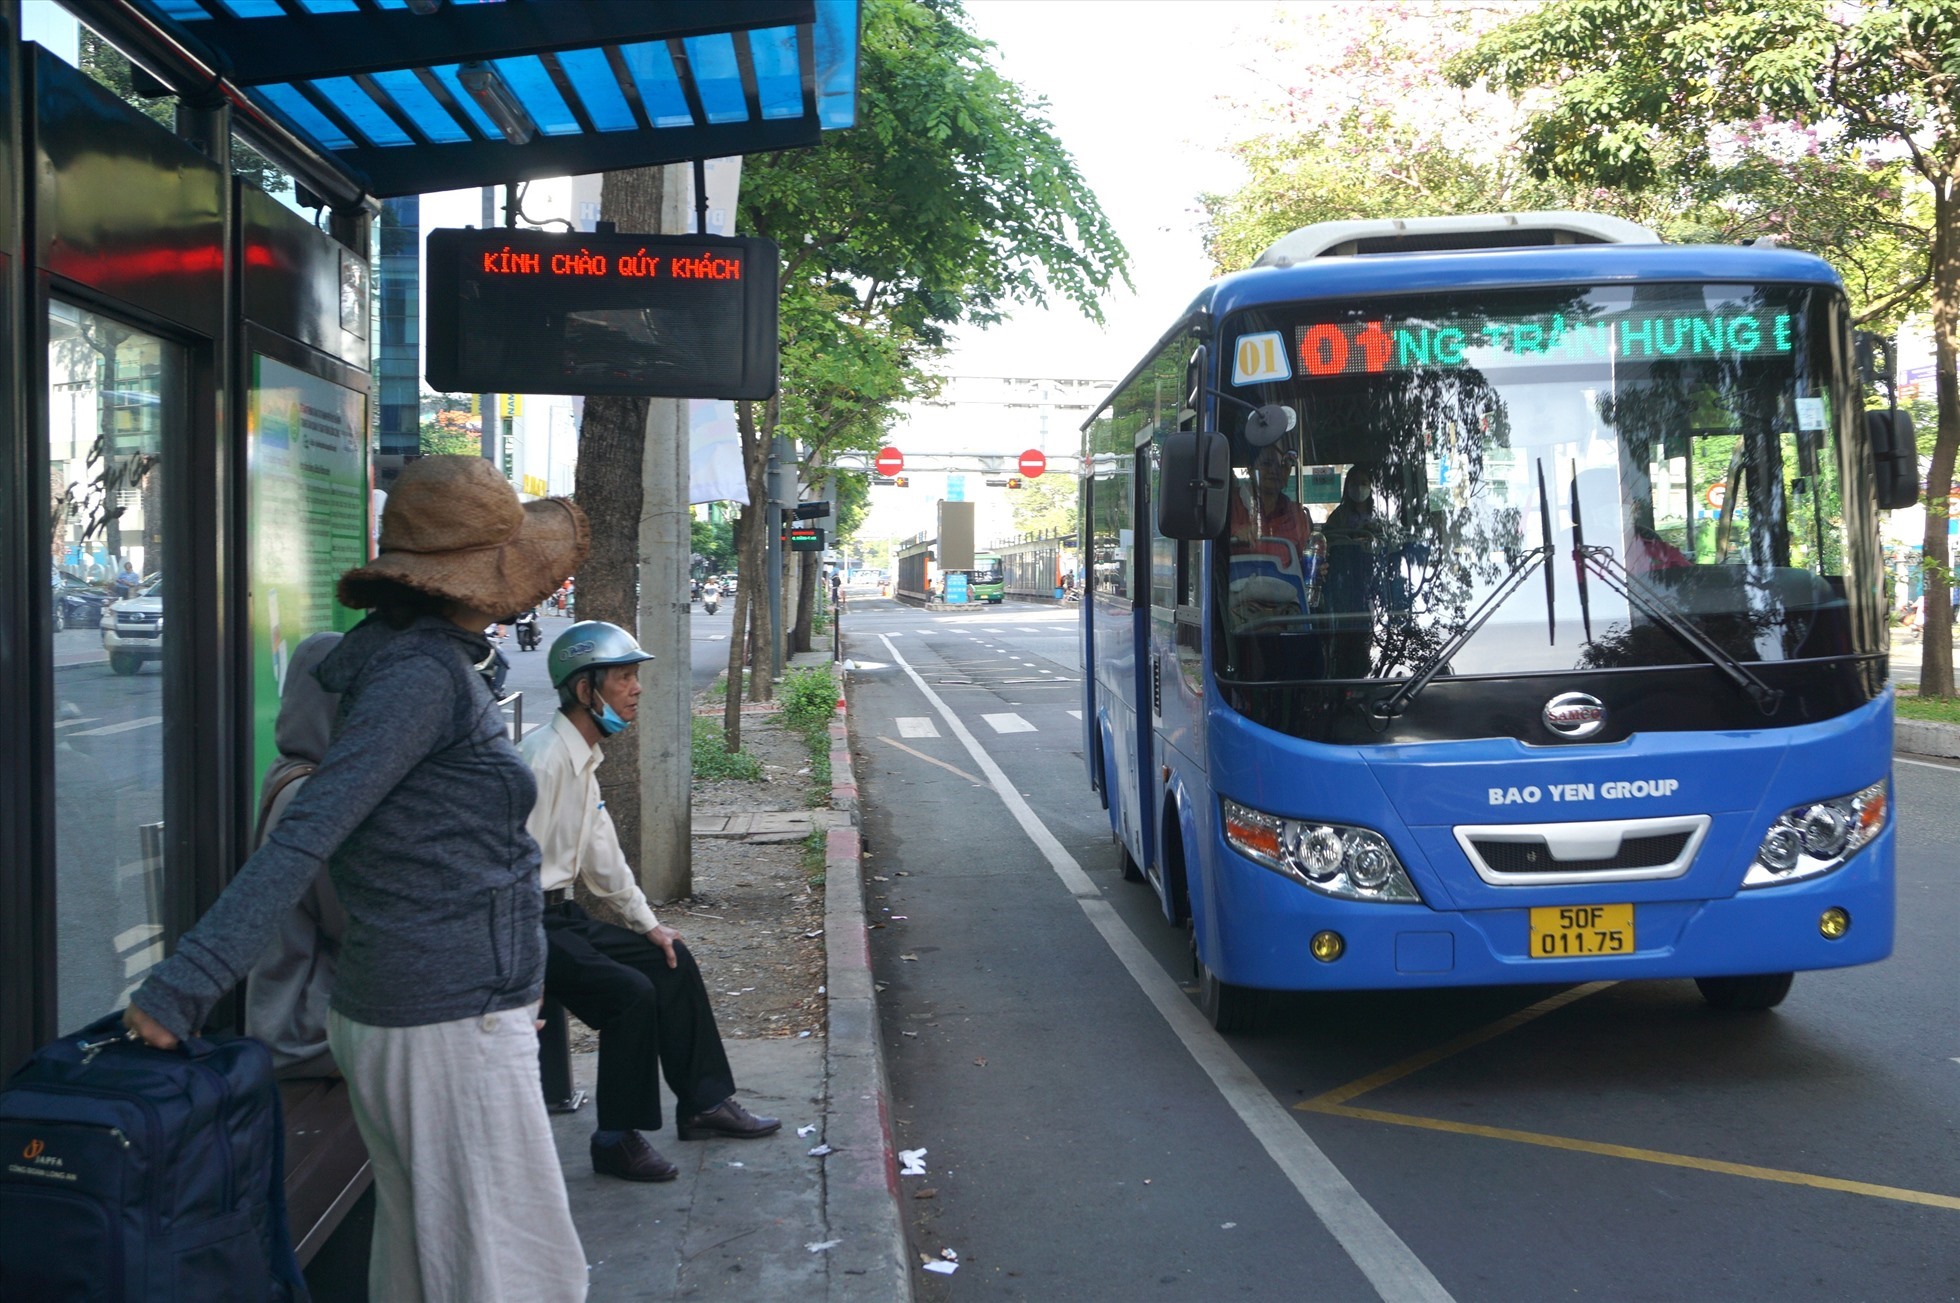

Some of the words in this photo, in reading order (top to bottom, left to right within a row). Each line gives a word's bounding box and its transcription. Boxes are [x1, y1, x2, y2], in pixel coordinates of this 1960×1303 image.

[484, 247, 540, 273] KÍNH
[551, 249, 607, 275] CHÀO
[618, 248, 660, 277] QÚY
[672, 252, 740, 279] KHÁCH
[1621, 315, 1761, 357] HƯNG
[1238, 338, 1278, 376] 01
[1548, 708, 1601, 721] SAMCO
[1488, 786, 1542, 805] BAO
[1548, 783, 1595, 802] YEN
[1600, 779, 1680, 799] GROUP
[1560, 907, 1604, 930] 50F
[1542, 931, 1623, 954] 011.75
